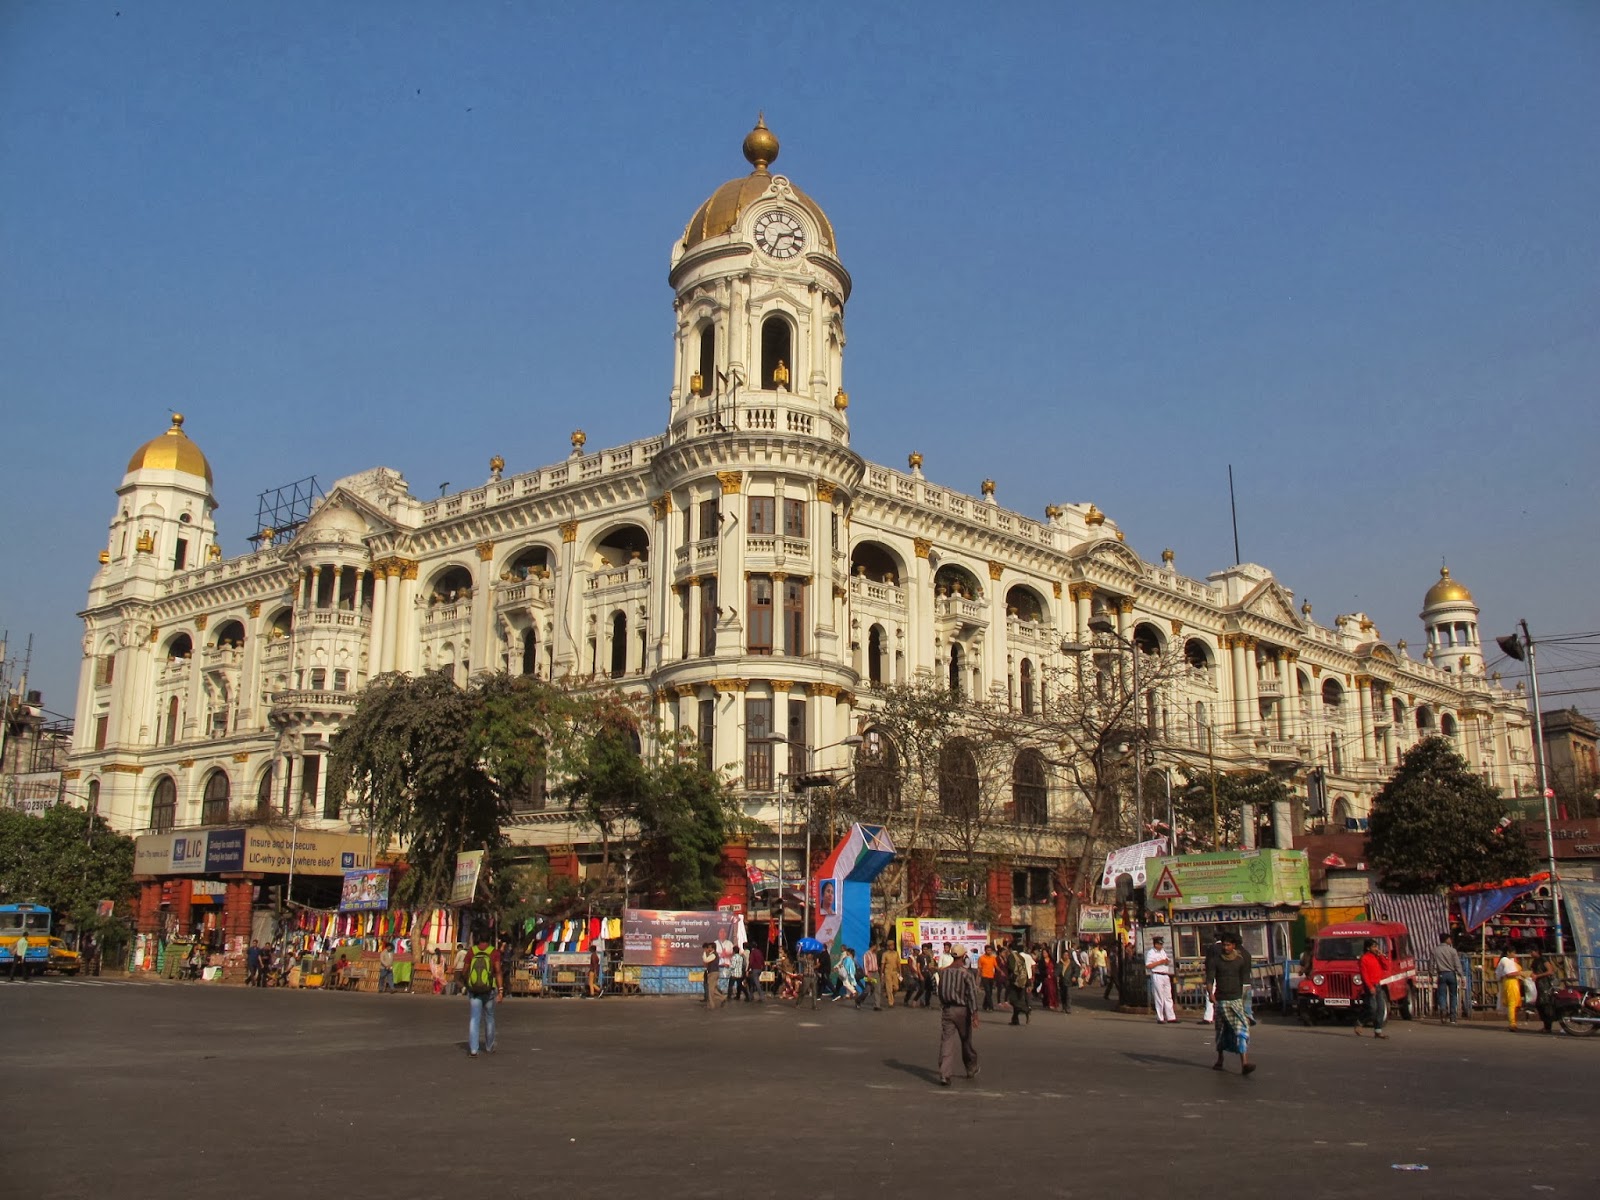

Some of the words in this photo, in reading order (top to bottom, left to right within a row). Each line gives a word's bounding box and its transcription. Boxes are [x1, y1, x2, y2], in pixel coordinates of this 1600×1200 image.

[187, 840, 202, 858] LIC
[250, 837, 271, 848] Insure
[273, 840, 284, 849] and
[295, 842, 318, 852] secure.
[277, 857, 285, 867] go
[287, 857, 317, 869] aywhere
[318, 857, 334, 868] else?
[1222, 908, 1267, 921] POLICE
